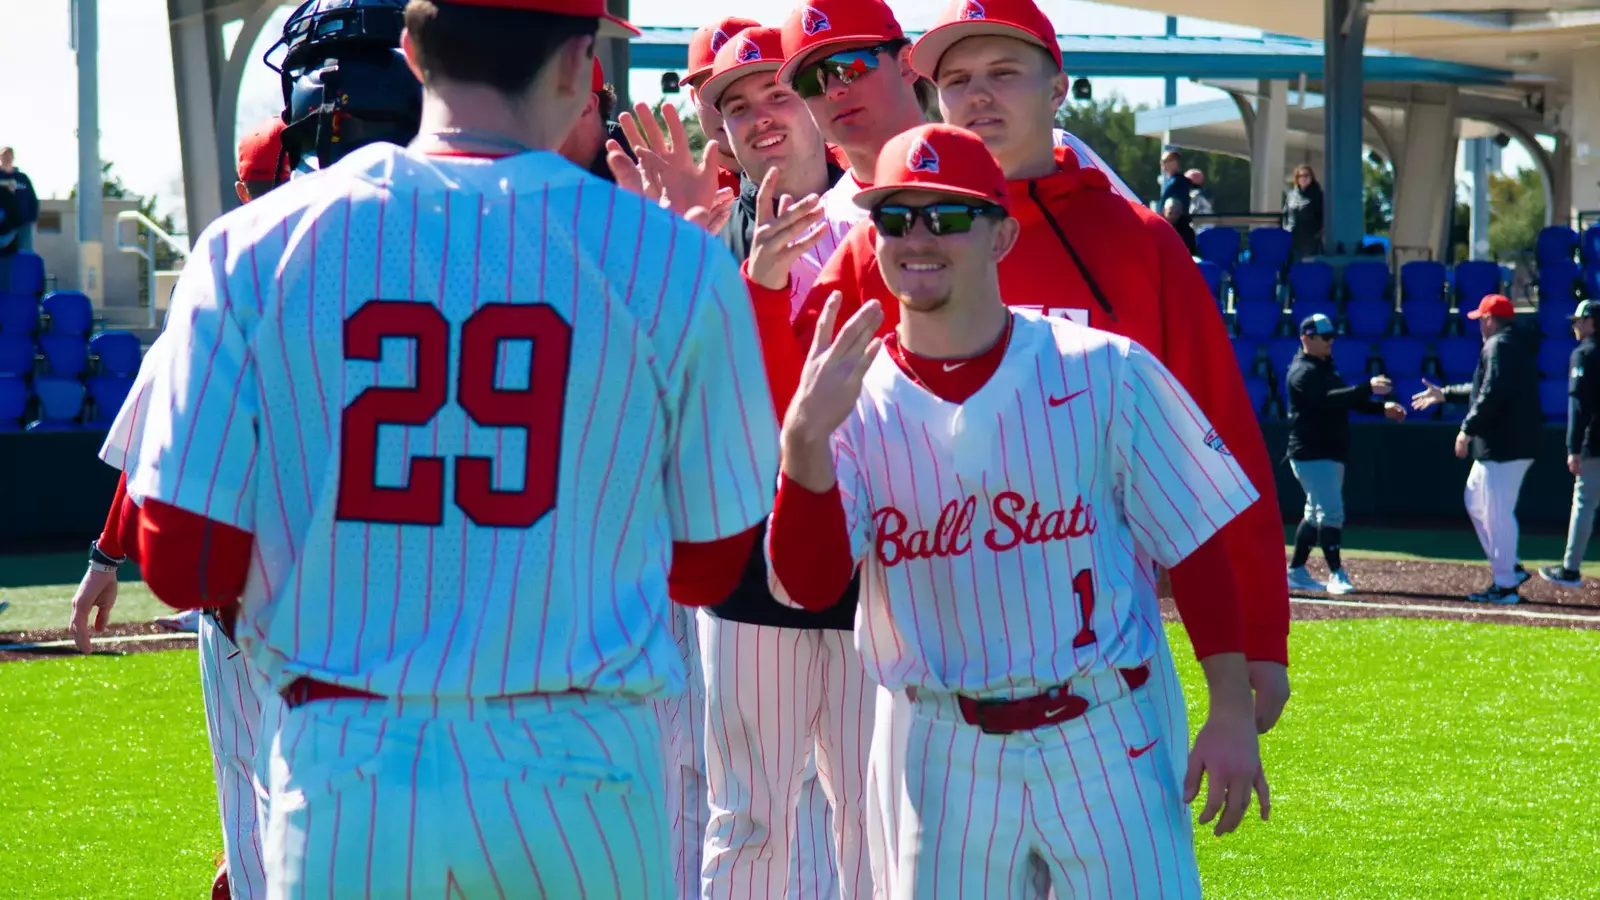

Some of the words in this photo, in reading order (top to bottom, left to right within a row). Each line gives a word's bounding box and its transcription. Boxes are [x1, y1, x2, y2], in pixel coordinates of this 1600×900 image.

[336, 300, 573, 529] 29
[872, 495, 977, 567] Ball
[984, 491, 1097, 552] State
[1072, 568, 1097, 649] 1
